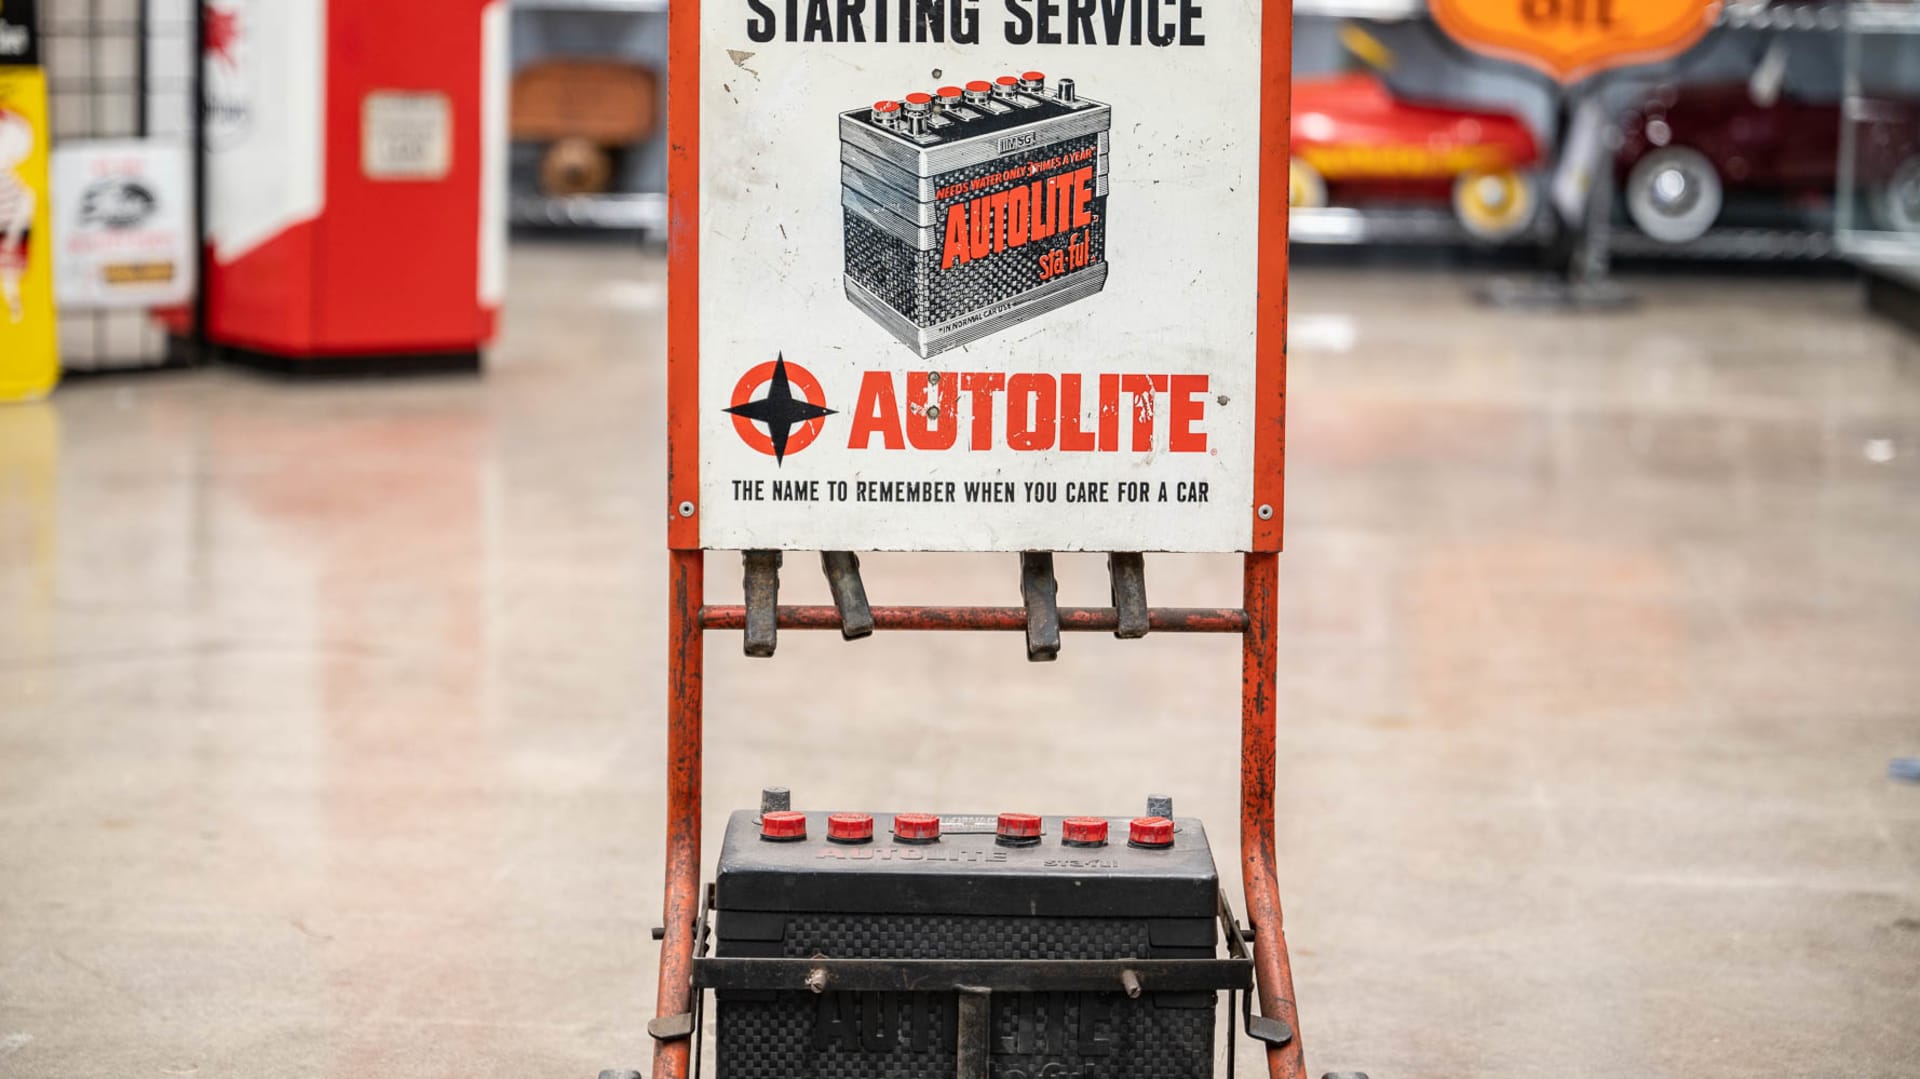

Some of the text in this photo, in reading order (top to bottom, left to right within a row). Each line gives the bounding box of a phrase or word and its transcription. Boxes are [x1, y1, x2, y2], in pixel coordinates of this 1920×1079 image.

[747, 0, 1205, 47] STARTING SERVICE
[935, 182, 969, 200] NEEDS
[970, 173, 1002, 191] WATER
[1002, 165, 1027, 181] ONLY
[1034, 156, 1062, 173] TIMES
[1062, 153, 1070, 165] A
[941, 166, 1093, 271] AUTOLITE
[951, 312, 982, 330] NORMAL
[847, 371, 1209, 453] AUTOLITE
[732, 480, 1209, 503] THE NAME TO REMEMBER WHEN YOU CARE FOR A CAR
[815, 847, 1008, 864] AUTOLITE
